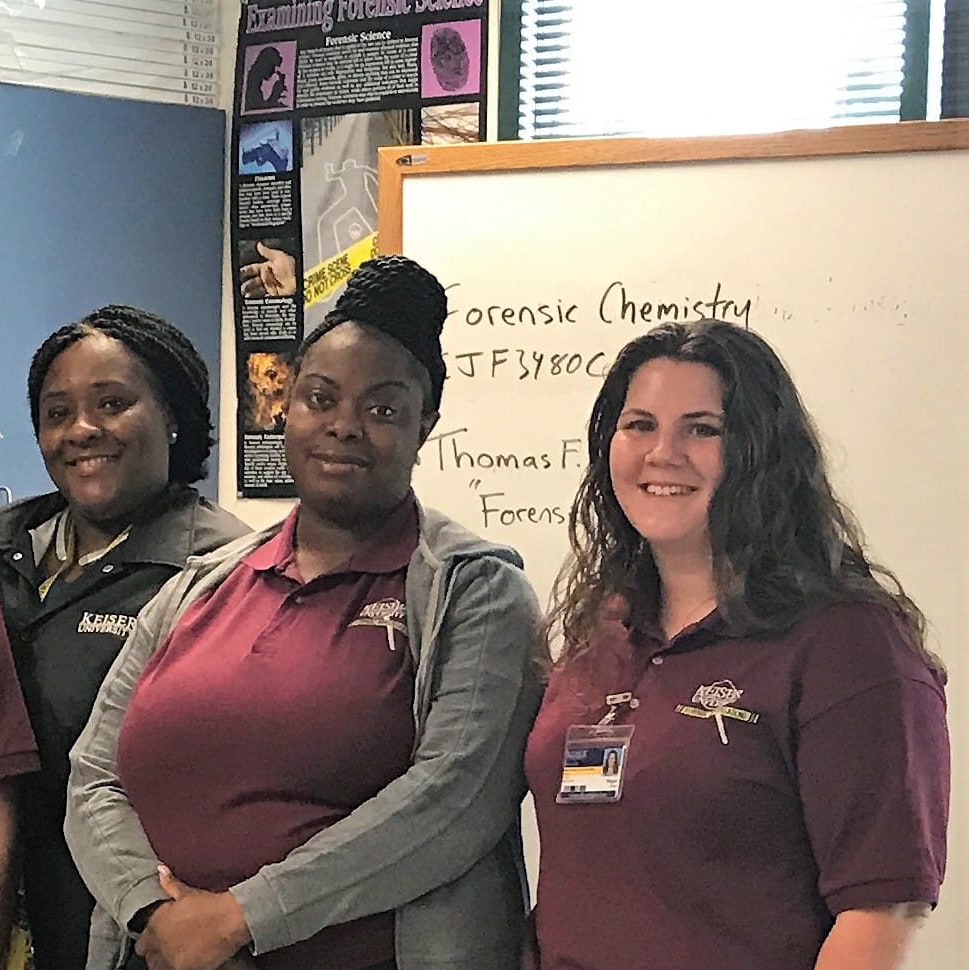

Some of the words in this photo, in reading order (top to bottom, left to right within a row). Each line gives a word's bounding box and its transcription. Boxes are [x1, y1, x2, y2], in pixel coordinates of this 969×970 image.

[245, 2, 334, 34] Examining
[359, 31, 392, 42] Science
[599, 281, 751, 329] Chemistry
[443, 347, 607, 380] JF3480C
[428, 427, 551, 471] Thomas
[562, 438, 582, 470] F.
[77, 622, 129, 637] UNIVERSIT
[80, 611, 137, 630] KEISER
